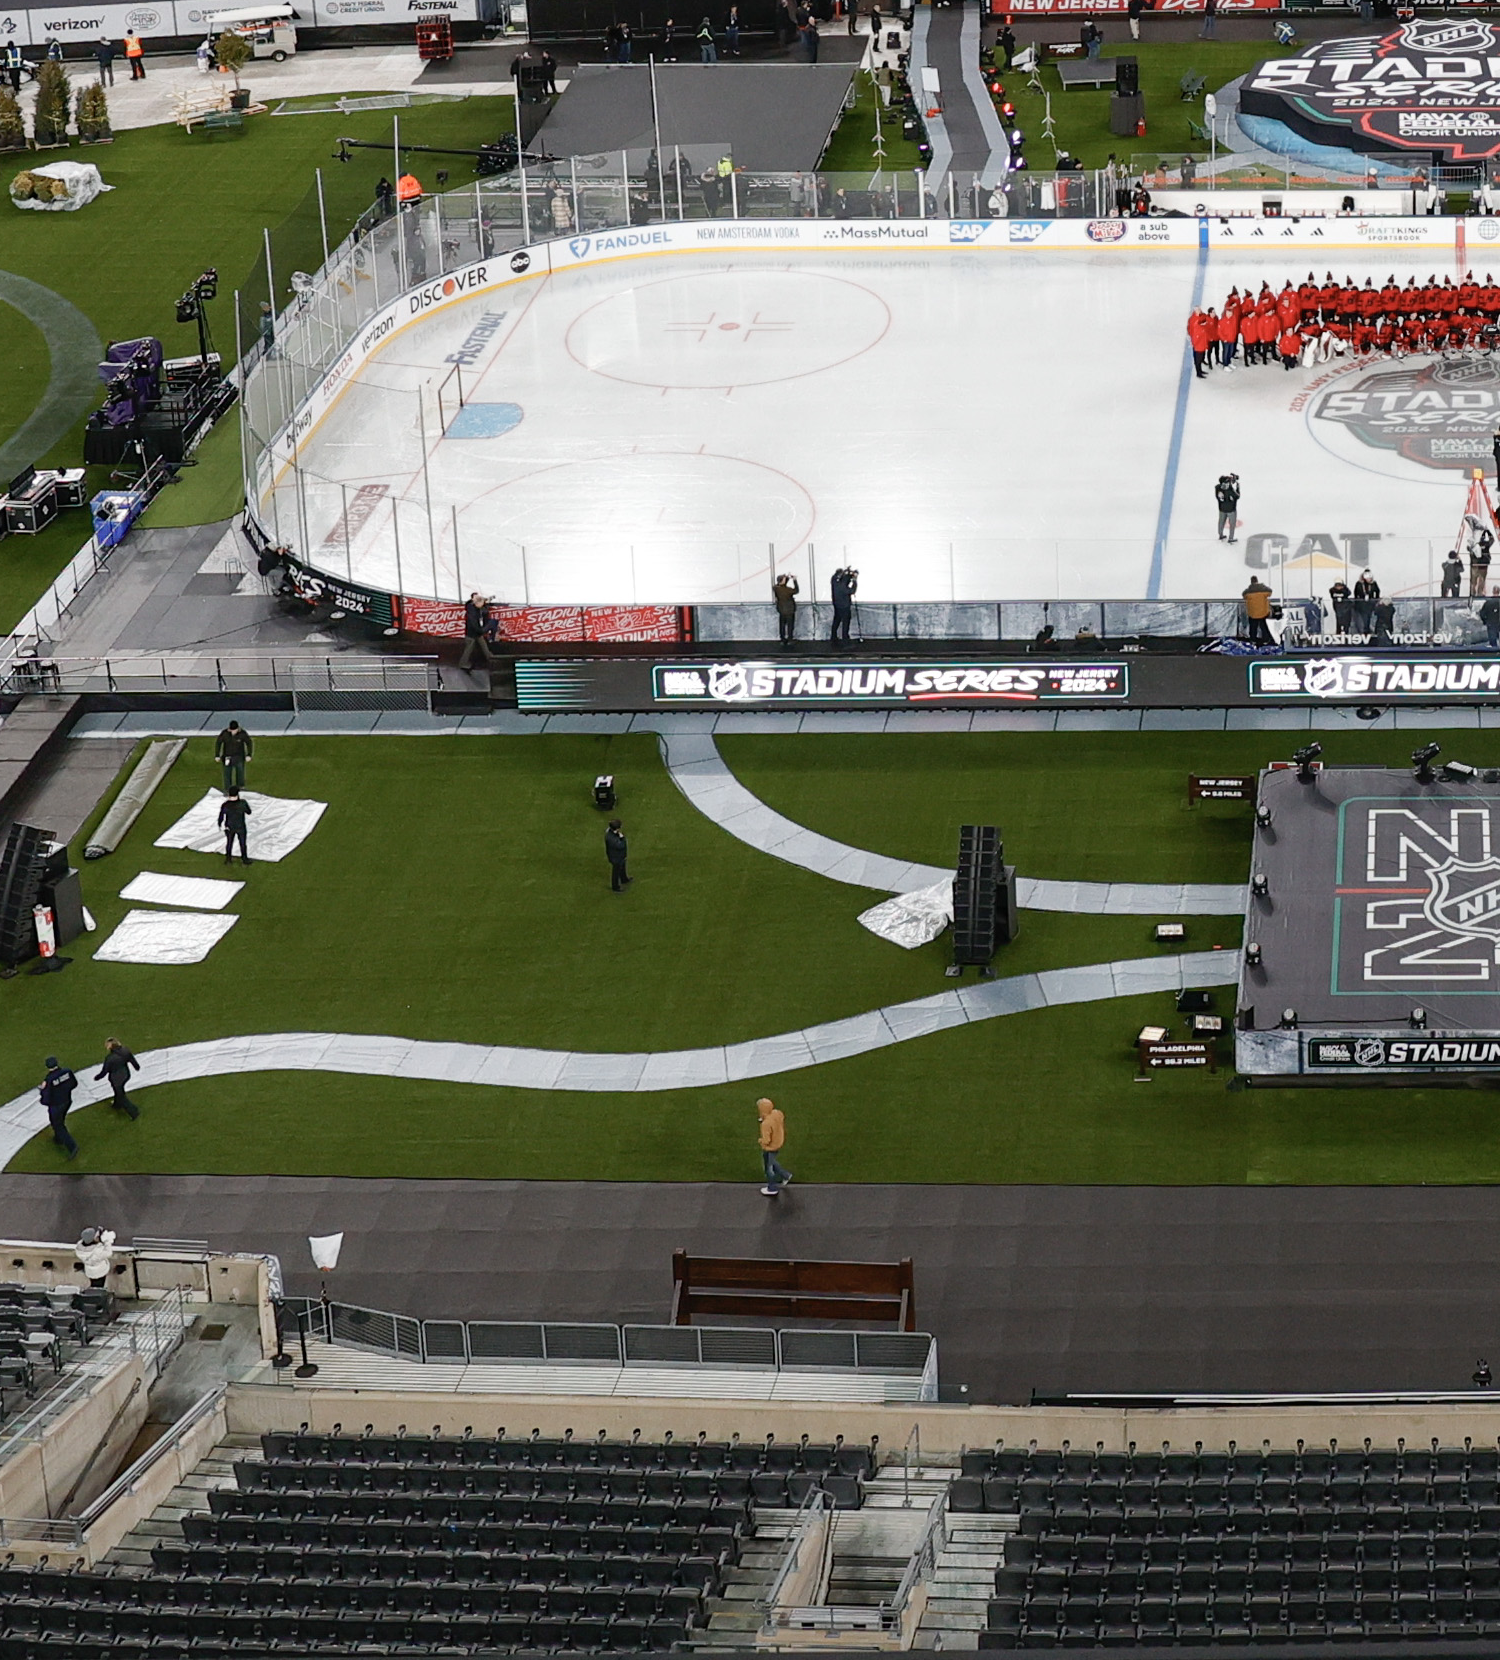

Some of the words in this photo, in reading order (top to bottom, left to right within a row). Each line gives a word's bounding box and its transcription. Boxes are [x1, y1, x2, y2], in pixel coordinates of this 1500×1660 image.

[44, 18, 99, 32] verizon
[1422, 26, 1474, 47] NHL
[1332, 97, 1398, 107] 2024
[1419, 97, 1479, 106] NEW
[1399, 112, 1466, 122] NAVY
[1399, 127, 1455, 138] Credit
[697, 228, 716, 240] NEW
[718, 226, 771, 240] AMSTERDAM
[773, 225, 800, 239] VODKA
[841, 225, 929, 240] MassMutual
[950, 223, 984, 241] SAP
[1149, 222, 1168, 231] sub
[595, 230, 672, 252] FANDUEL
[1138, 231, 1170, 241] above
[409, 267, 488, 314] DISCOVER
[443, 308, 508, 366] FASTENAL
[1382, 425, 1431, 434] 2024
[1244, 532, 1382, 570] CAT
[1048, 670, 1075, 678] NEW
[1076, 670, 1119, 678] JERSEY
[1346, 664, 1500, 691] STADIUM
[750, 669, 908, 695] STADIUM
[905, 668, 1046, 692] SERIES
[1060, 679, 1109, 693] 2024
[1149, 1045, 1206, 1053] PHILADELPHIA
